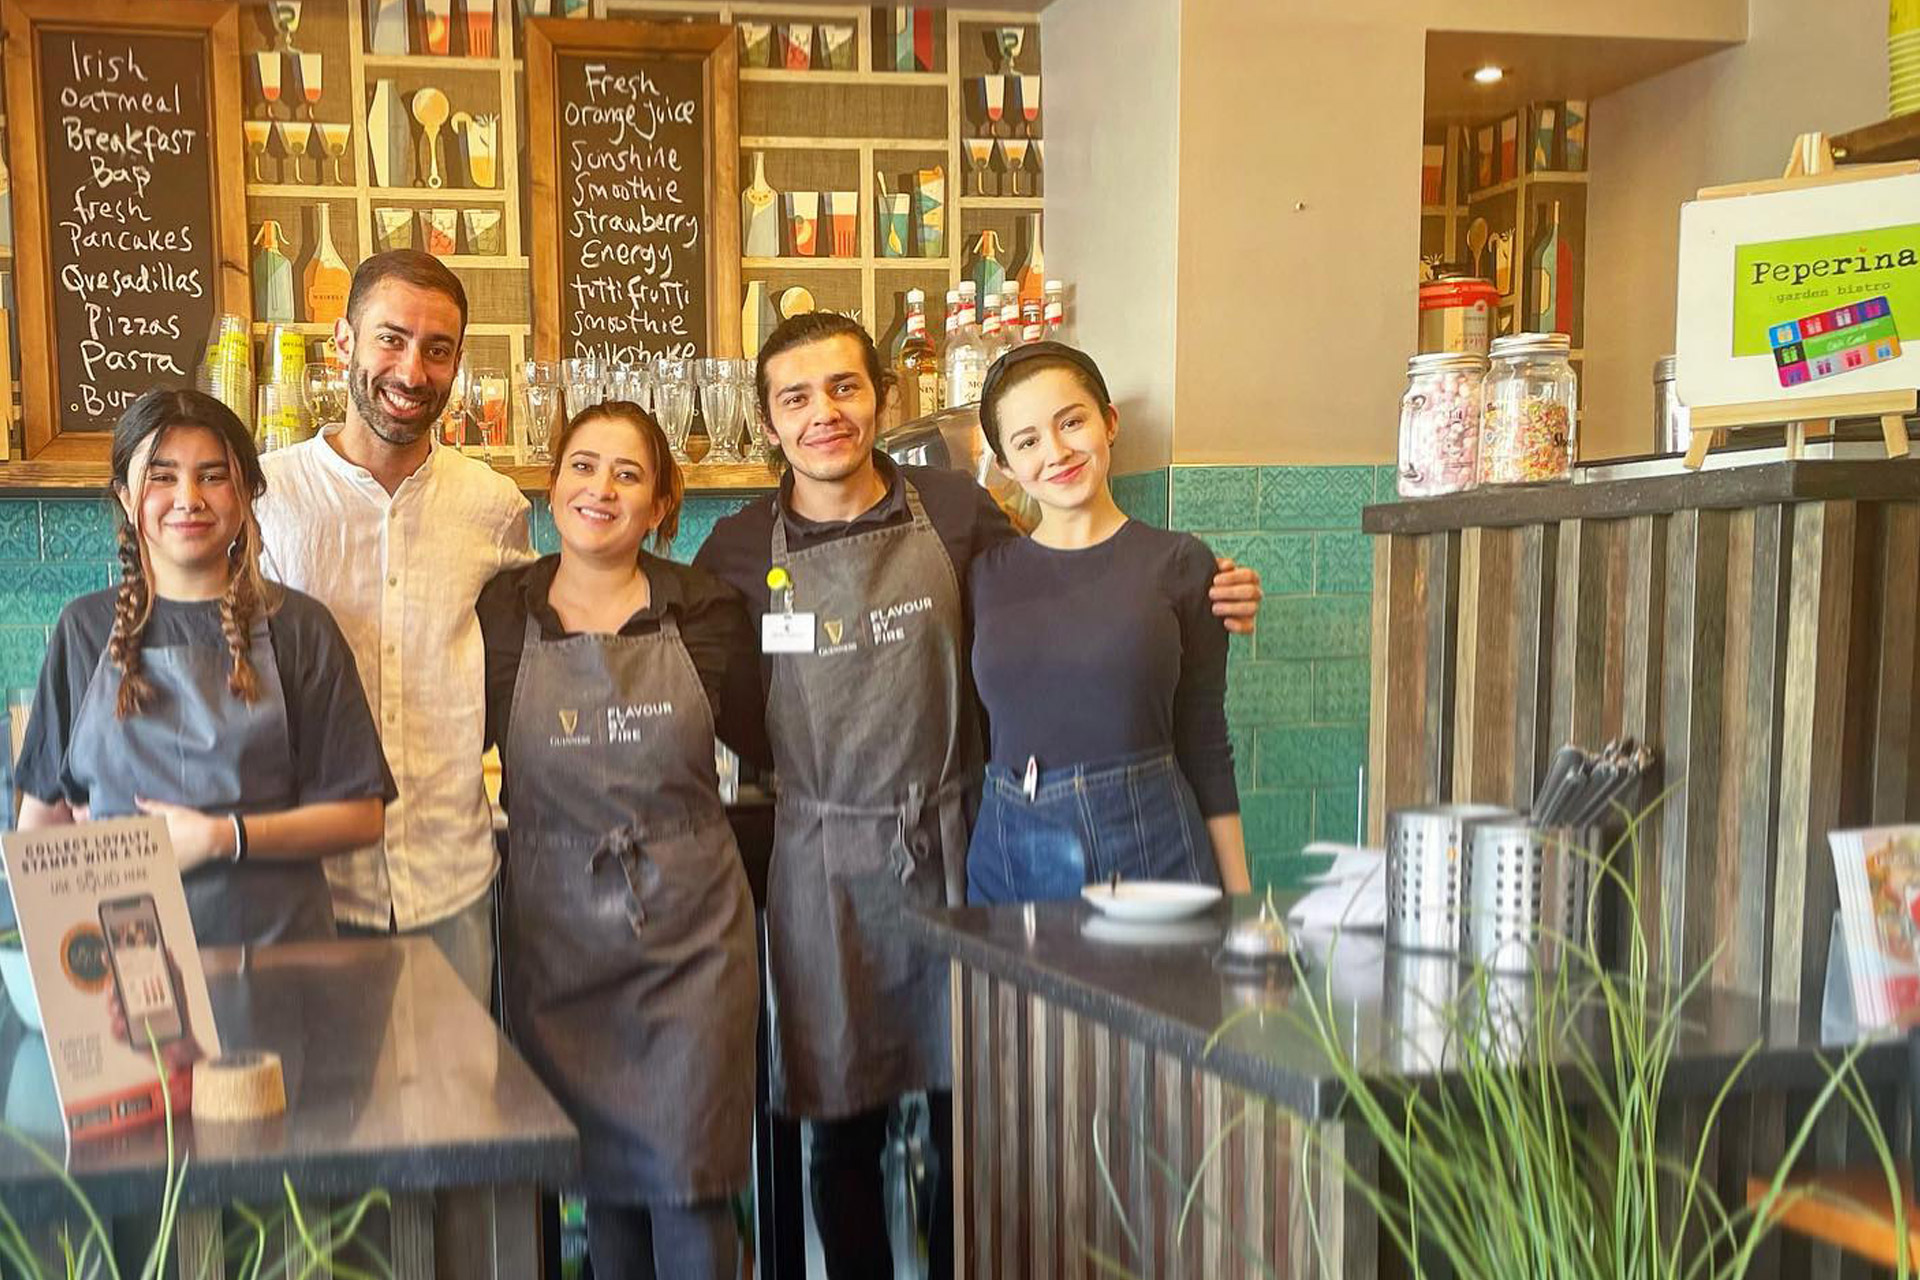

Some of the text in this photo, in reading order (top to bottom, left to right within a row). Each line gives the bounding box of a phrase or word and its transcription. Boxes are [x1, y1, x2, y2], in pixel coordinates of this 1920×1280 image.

[72, 40, 148, 82] Irish
[585, 65, 659, 100] Fresh
[63, 117, 196, 162] Breakfast
[90, 157, 152, 196] Bap
[60, 221, 193, 257] Pancakes
[580, 240, 672, 279] Energy
[1752, 247, 1918, 285] Peperina
[61, 263, 203, 300] Quesadillas
[1776, 281, 1891, 304] garden bistro
[84, 302, 181, 340] Pizzas
[79, 341, 185, 381] Pasta
[870, 597, 932, 622] FLAVOUR
[873, 619, 890, 634] BY
[874, 627, 905, 646] FIRE
[607, 701, 672, 719] FLAVOUR
[609, 729, 642, 744] FIRE
